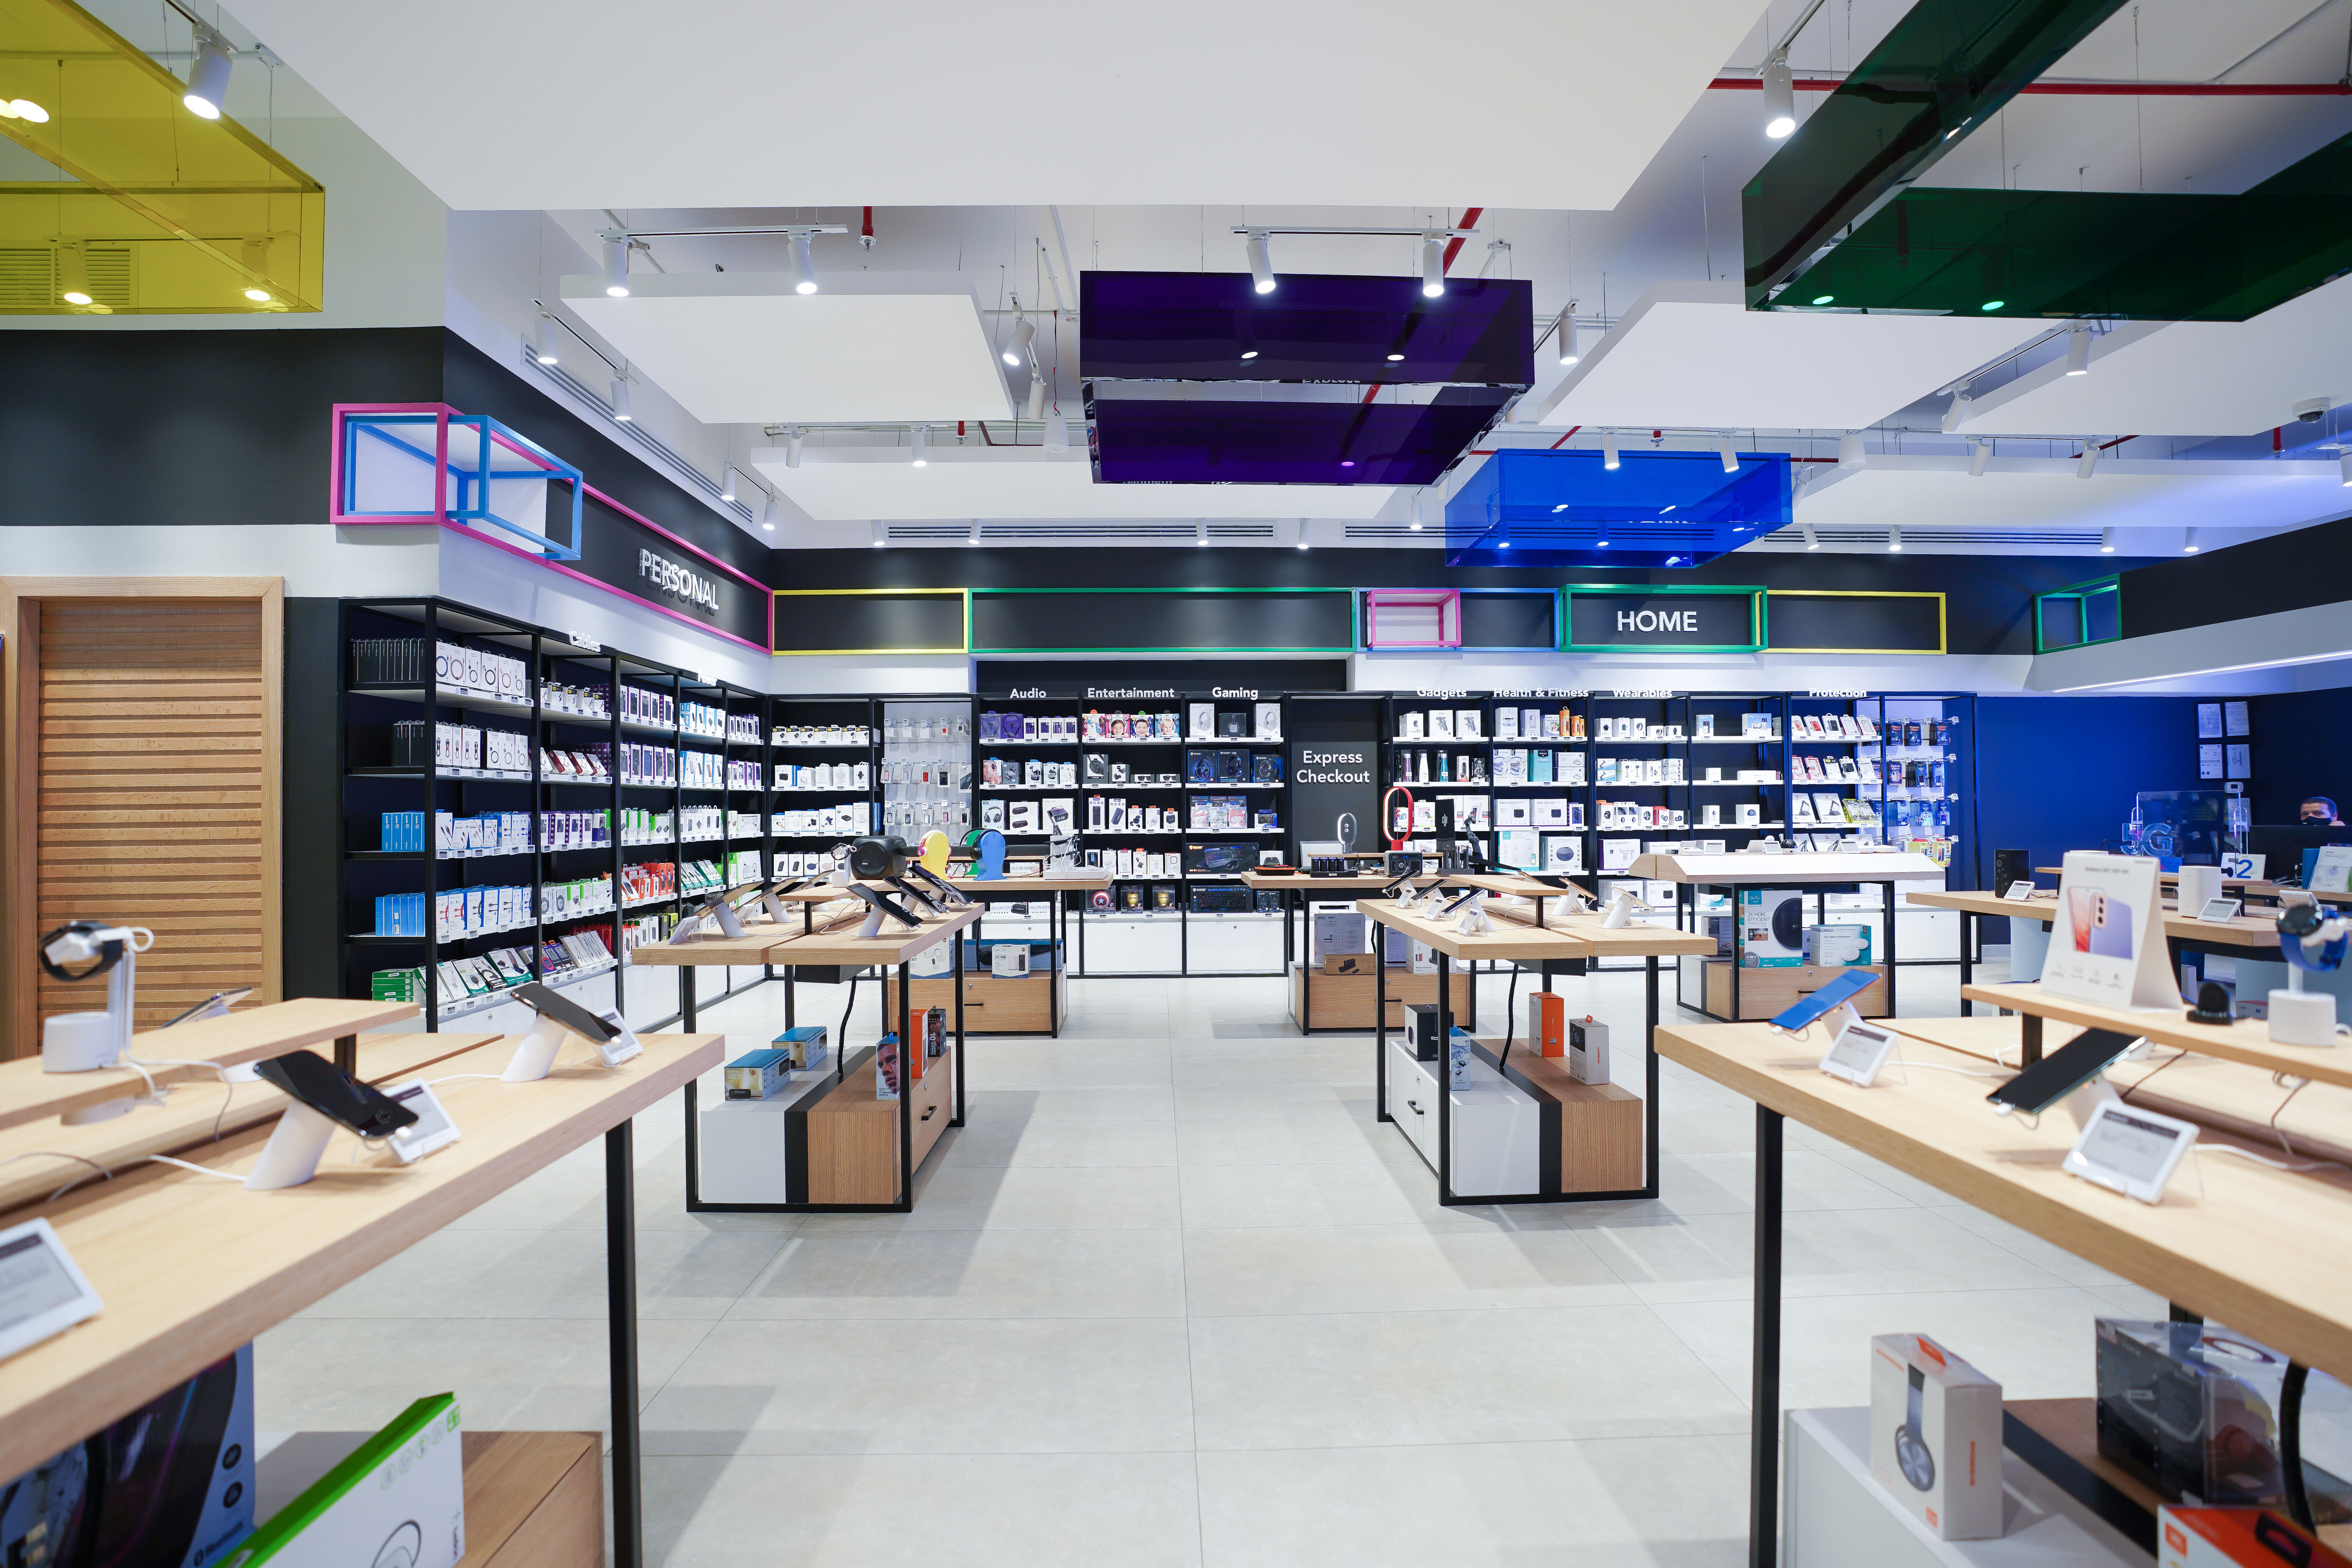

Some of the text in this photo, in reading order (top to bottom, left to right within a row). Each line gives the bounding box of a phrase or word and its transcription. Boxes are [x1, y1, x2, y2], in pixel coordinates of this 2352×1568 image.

[639, 548, 719, 610] PERSONAL
[1617, 611, 1697, 632] HOME
[569, 631, 601, 652] Cables
[1010, 688, 1046, 698] Audio
[1088, 688, 1174, 698] Entertainment
[1212, 687, 1258, 700] Gaming
[1417, 687, 1467, 700] Gadgets
[1494, 687, 1589, 697] Health & Fitness
[1613, 688, 1672, 698] Wearables
[1809, 688, 1866, 698] Protection
[1303, 750, 1362, 767] Express
[1297, 769, 1370, 783] Checkout
[2120, 823, 2172, 857] 5G
[930, 1032, 936, 1041] 10
